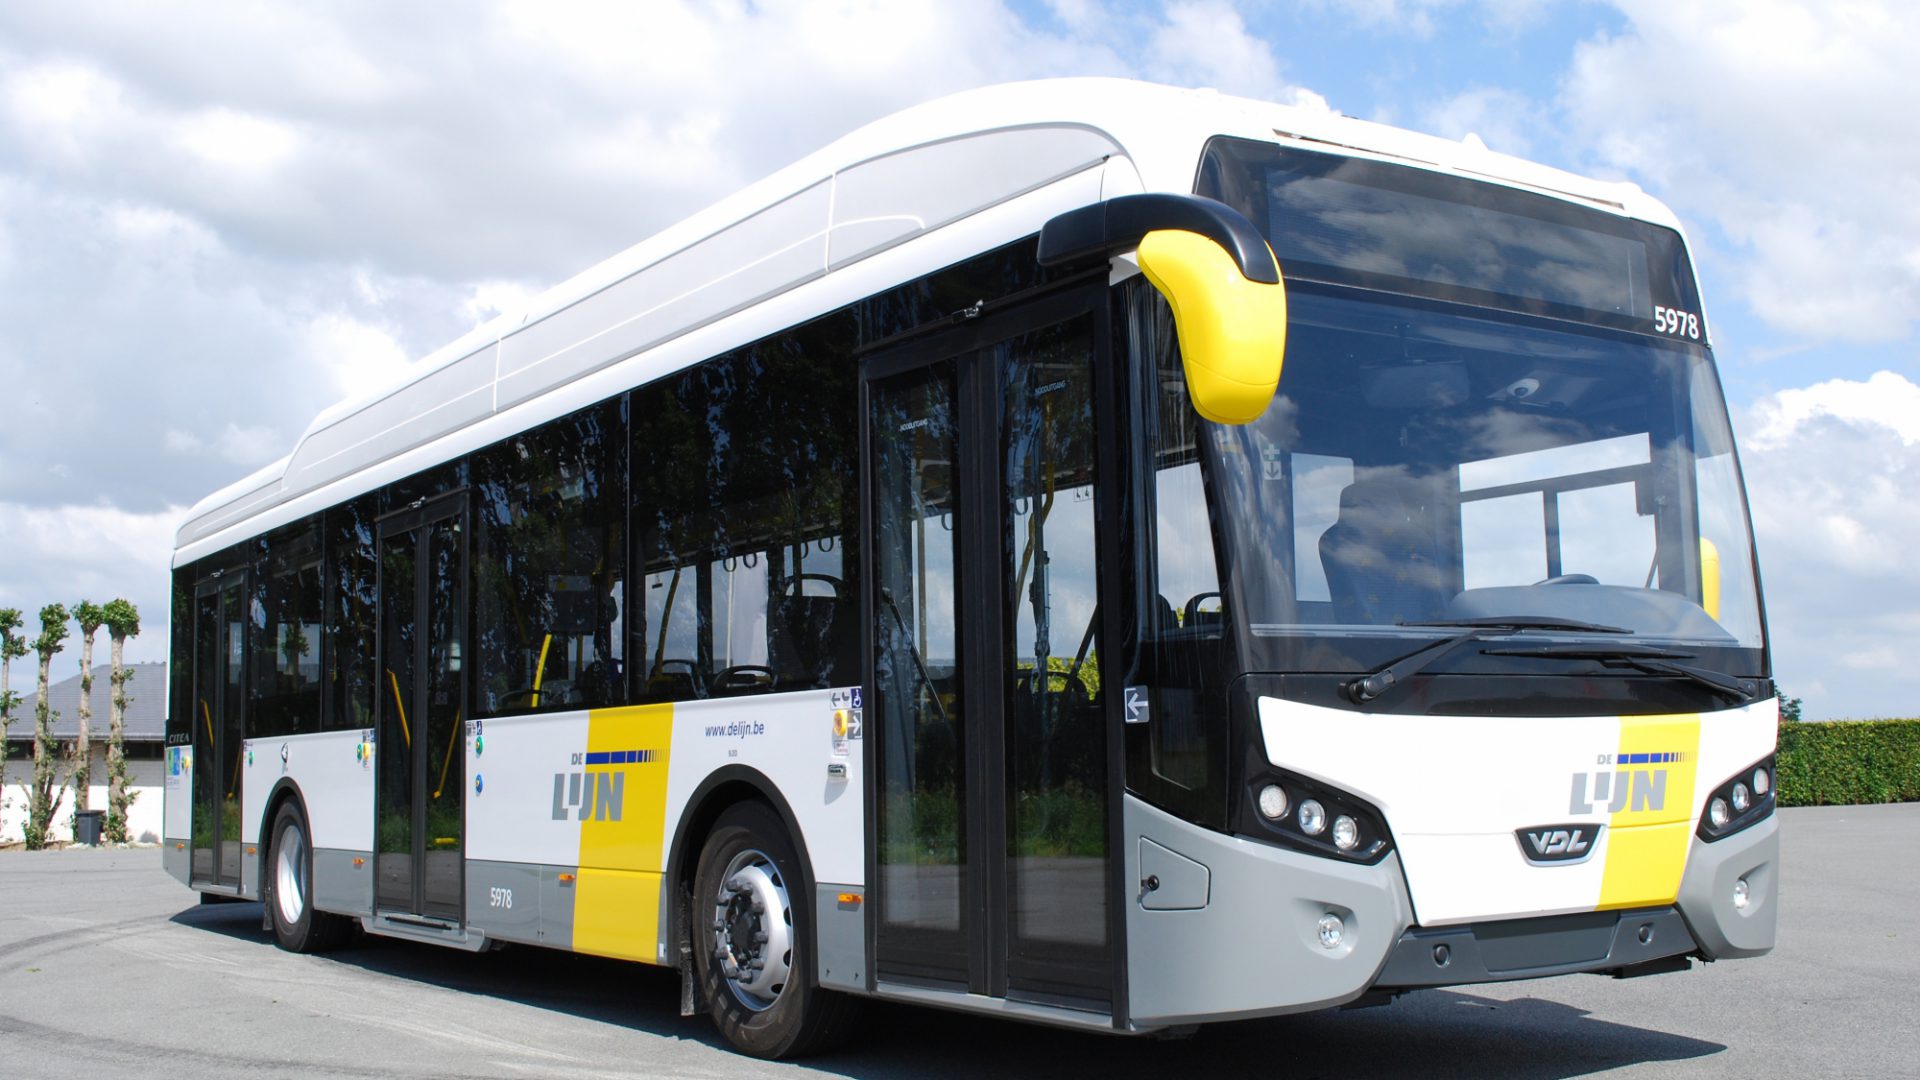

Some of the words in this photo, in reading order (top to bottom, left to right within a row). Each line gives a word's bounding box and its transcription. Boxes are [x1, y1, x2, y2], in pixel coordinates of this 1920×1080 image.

[1654, 305, 1699, 340] 5978
[169, 733, 190, 744] CITEA
[705, 721, 765, 740] www.delijn.be
[571, 752, 583, 765] DE
[1596, 754, 1612, 765] DE
[552, 772, 625, 822] LIJN
[1569, 769, 1667, 815] LIJN
[1528, 830, 1588, 854] VDL
[490, 887, 513, 909] 5978
